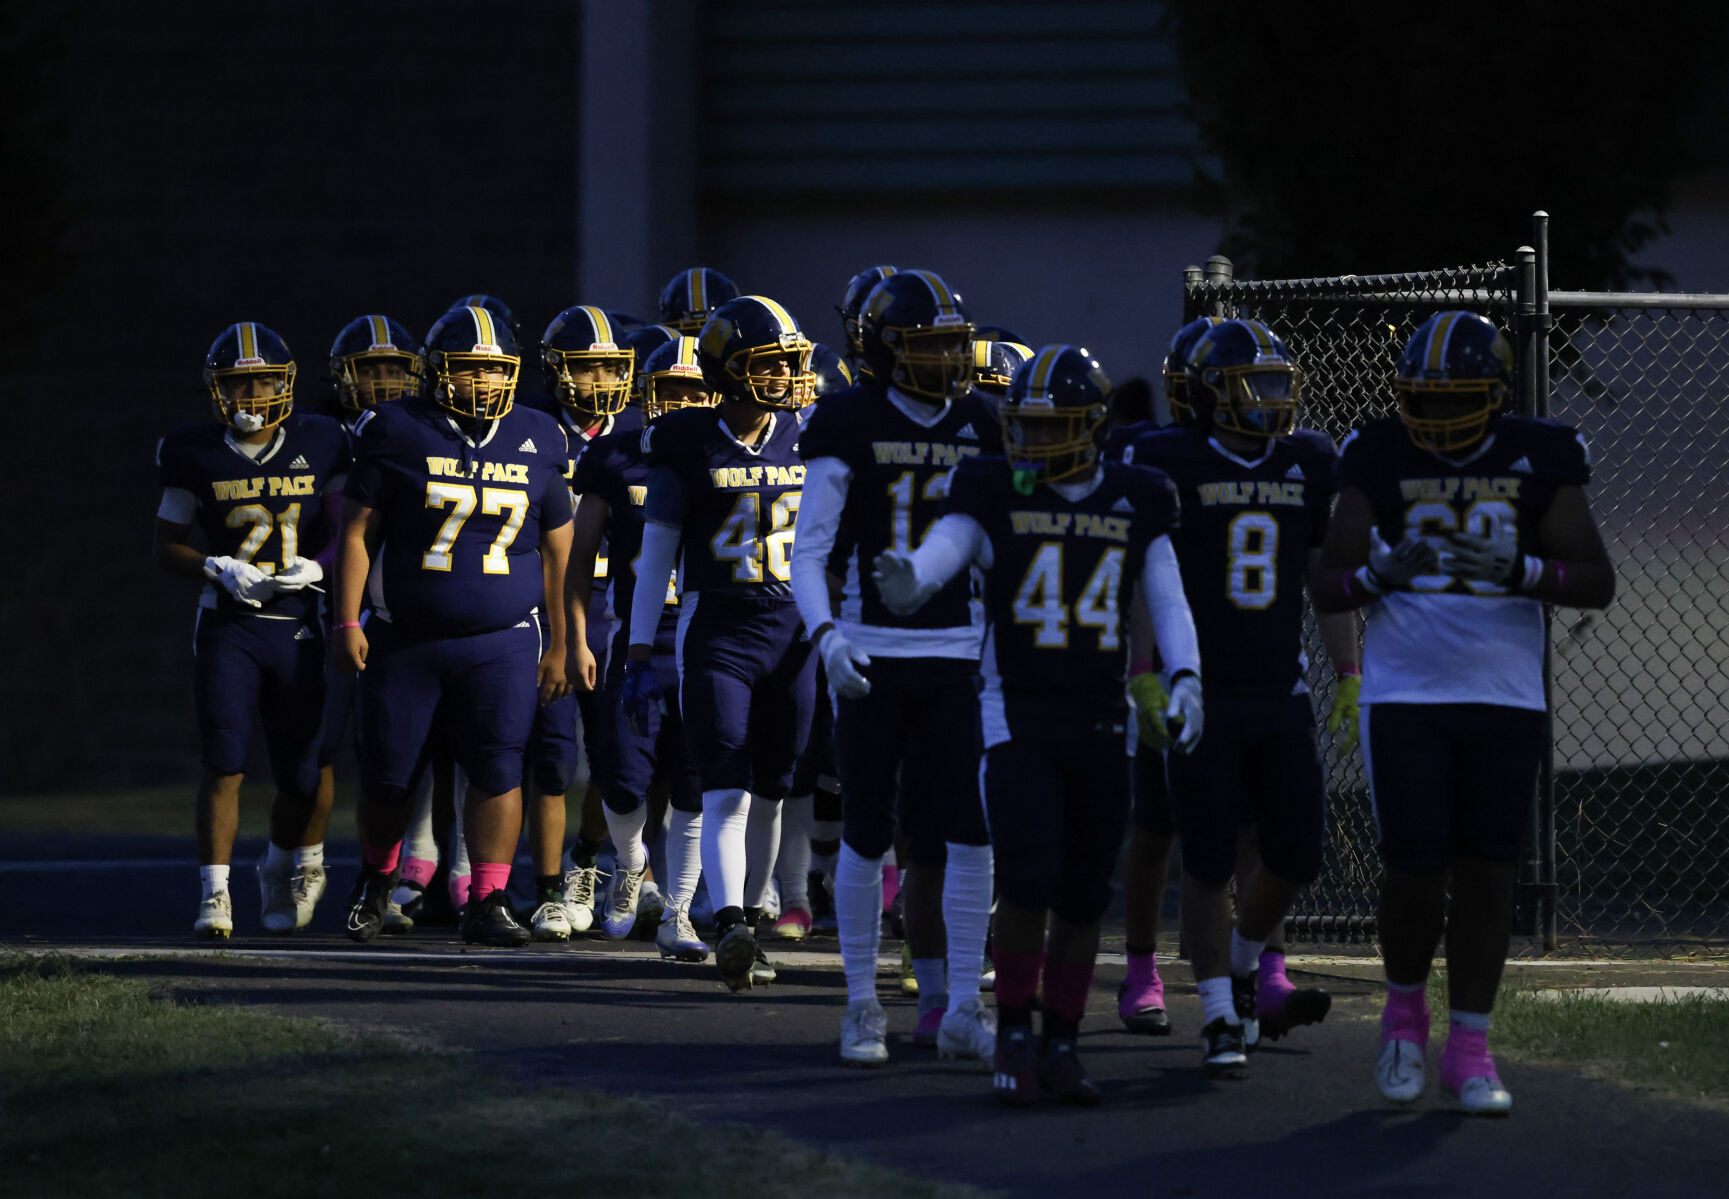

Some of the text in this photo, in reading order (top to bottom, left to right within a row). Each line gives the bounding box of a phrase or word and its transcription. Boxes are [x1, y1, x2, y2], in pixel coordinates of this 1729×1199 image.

[872, 441, 929, 465] WOLF
[481, 462, 529, 485] PACK
[709, 466, 763, 488] WOLF
[212, 475, 315, 500] WOLF PACK
[1197, 481, 1305, 507] WOLF PACK
[1398, 476, 1522, 501] WOLF PACK
[225, 502, 302, 577] 21
[422, 481, 530, 575] 77
[1010, 511, 1131, 543] WOLF PACK
[1226, 511, 1280, 611] 8
[1011, 541, 1127, 652] 44
